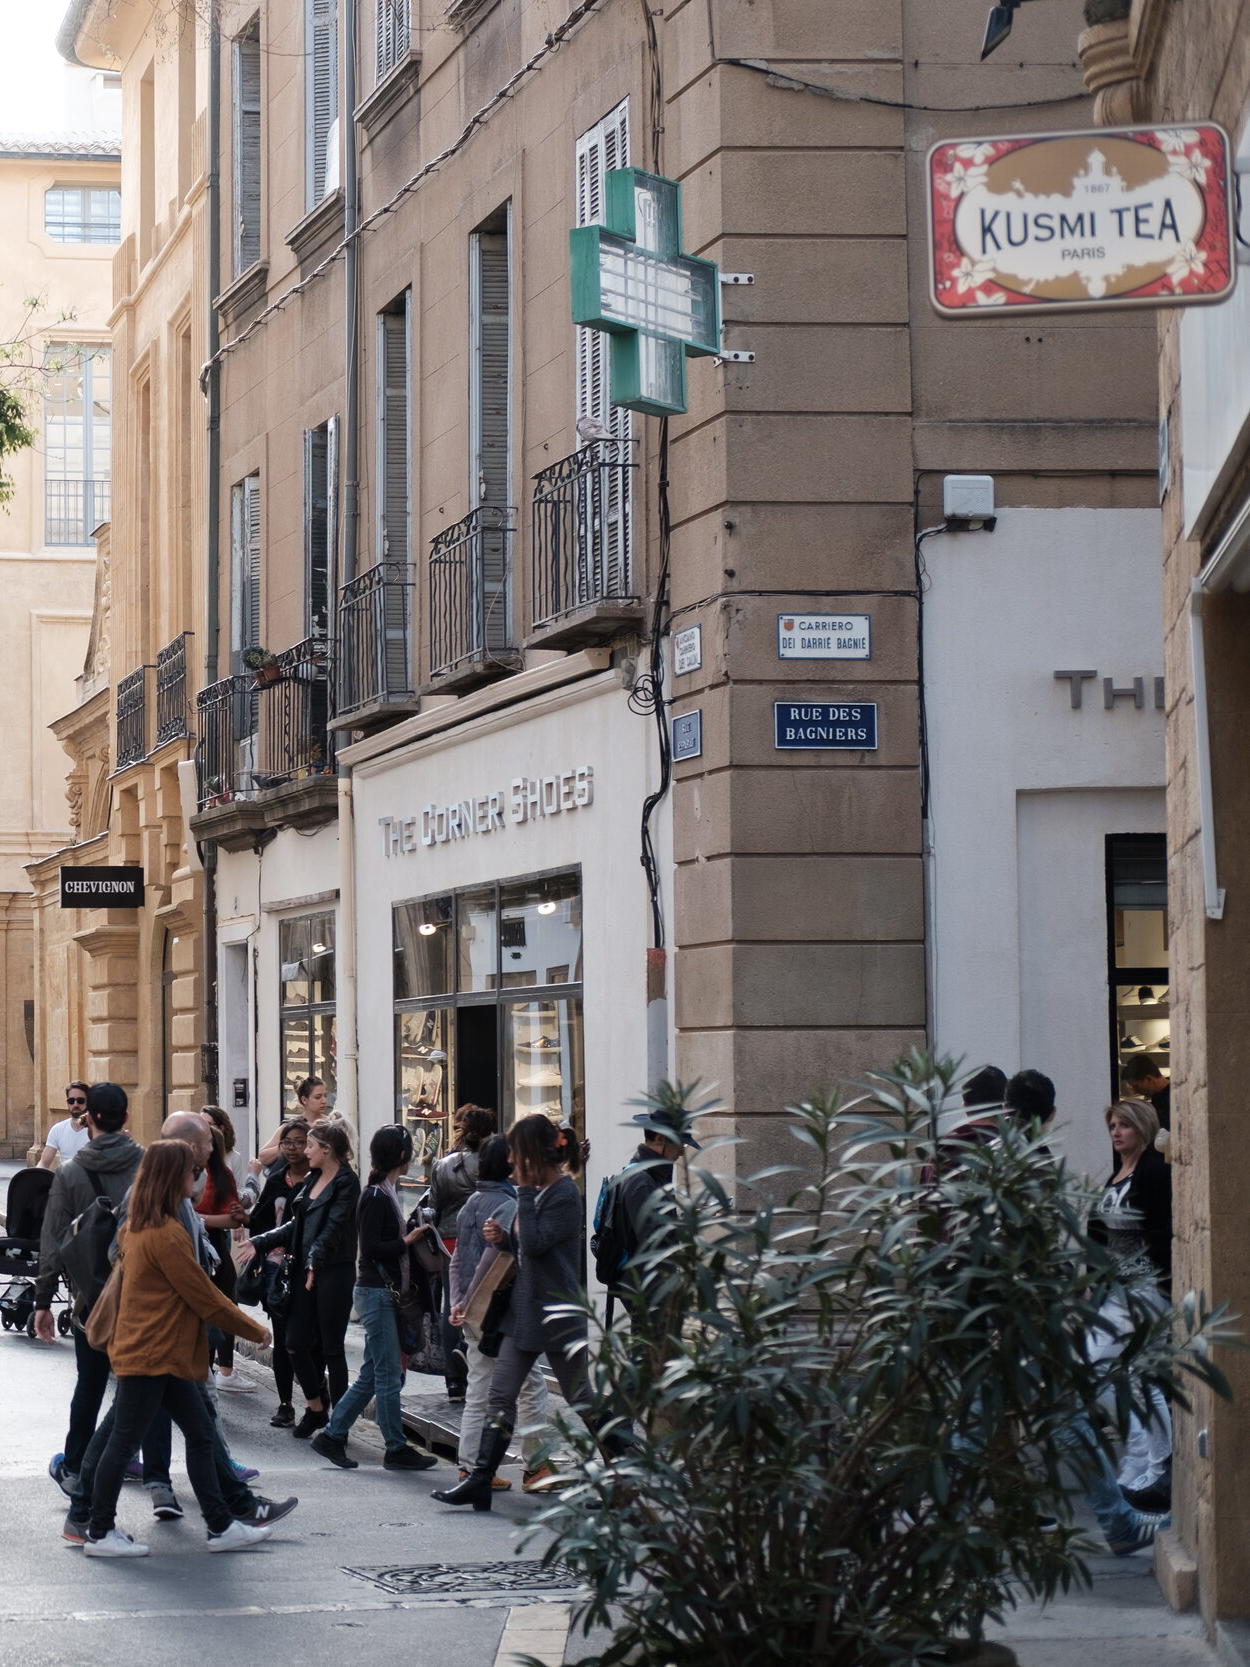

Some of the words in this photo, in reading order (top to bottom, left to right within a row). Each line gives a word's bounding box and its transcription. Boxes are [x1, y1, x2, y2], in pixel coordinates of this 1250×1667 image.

[1084, 183, 1110, 194] 1867
[979, 207, 1096, 255] KUSMI
[1110, 198, 1181, 243] TEA
[1061, 246, 1106, 261] PARIS
[798, 621, 854, 631] CARRIERO
[782, 637, 796, 649] DEI
[1053, 669, 1165, 710] TH
[790, 708, 822, 720] RUE
[829, 708, 861, 721] DES
[786, 727, 867, 740] BAGNIERS
[378, 815, 417, 857] THE
[421, 791, 506, 846] CORNER
[510, 765, 594, 824] SHOES
[65, 881, 135, 893] CHEVIGNON
[255, 1504, 270, 1519] N
